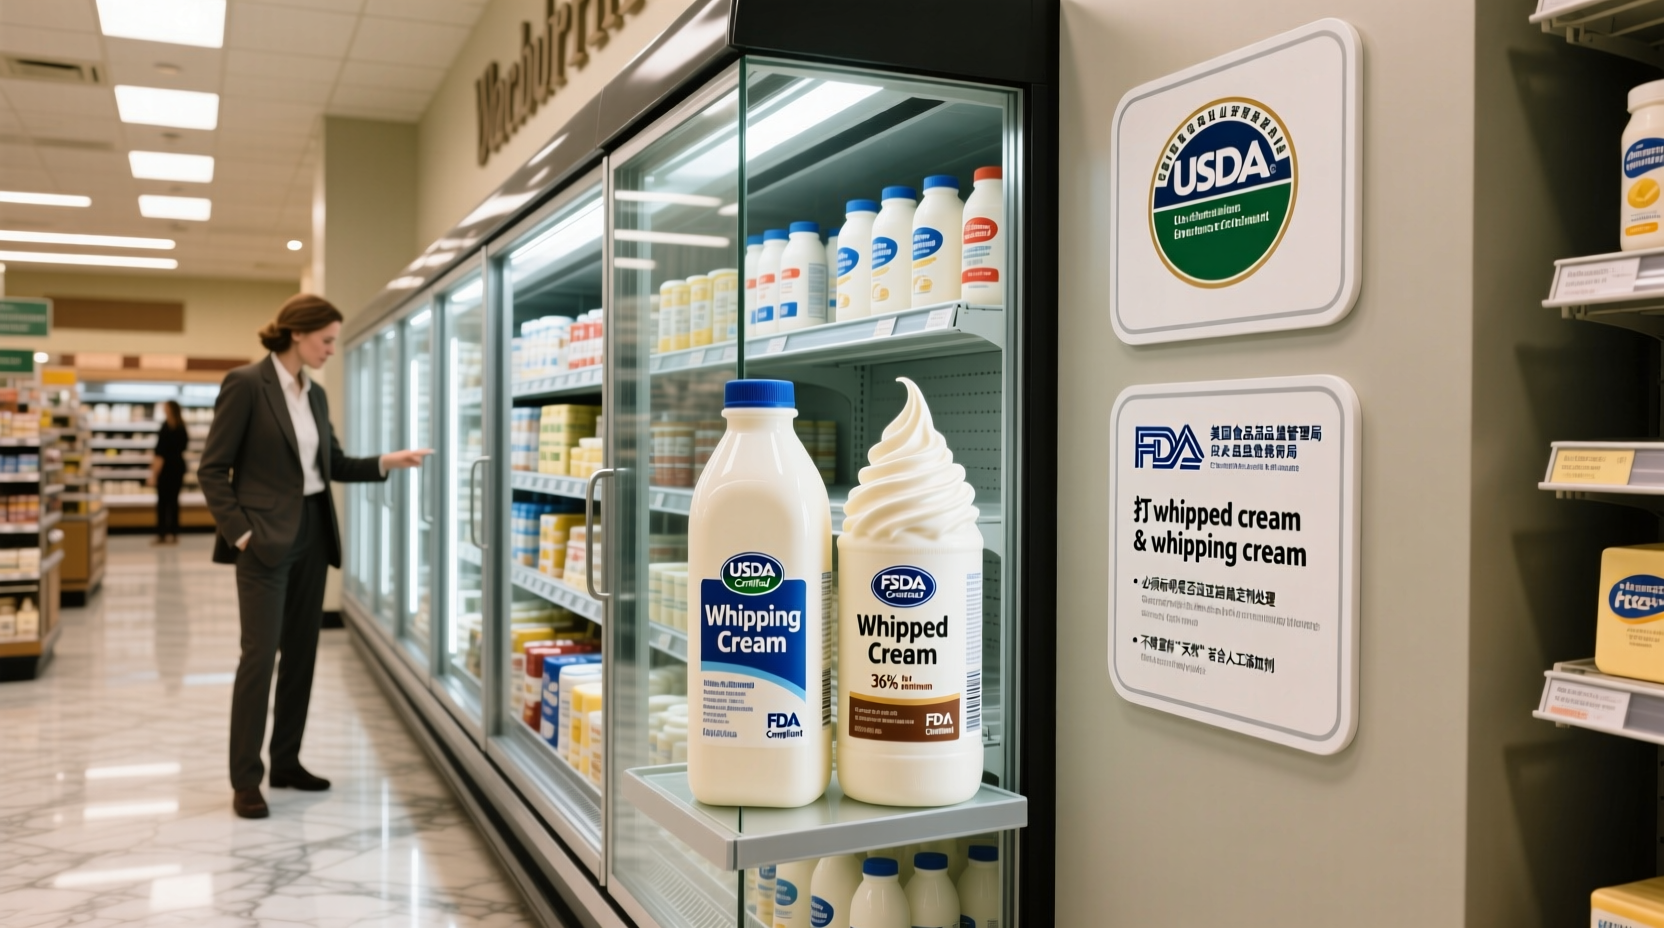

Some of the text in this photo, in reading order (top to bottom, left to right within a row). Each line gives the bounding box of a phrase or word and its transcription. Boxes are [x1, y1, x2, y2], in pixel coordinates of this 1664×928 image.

[1173, 139, 1270, 197] USDA
[1134, 424, 1205, 470] FDA
[1153, 498, 1233, 532] whipped
[1238, 504, 1302, 532] cream
[1133, 529, 1307, 567] & whipping cream
[729, 561, 776, 578] USDA
[880, 574, 927, 591] FSDA
[705, 604, 802, 633] Whipping
[857, 613, 949, 644] Whipped
[717, 631, 787, 653] Cream
[868, 642, 937, 665] Cream
[870, 673, 899, 690] 36%
[767, 712, 801, 728] FDA
[925, 712, 953, 727] FDA
